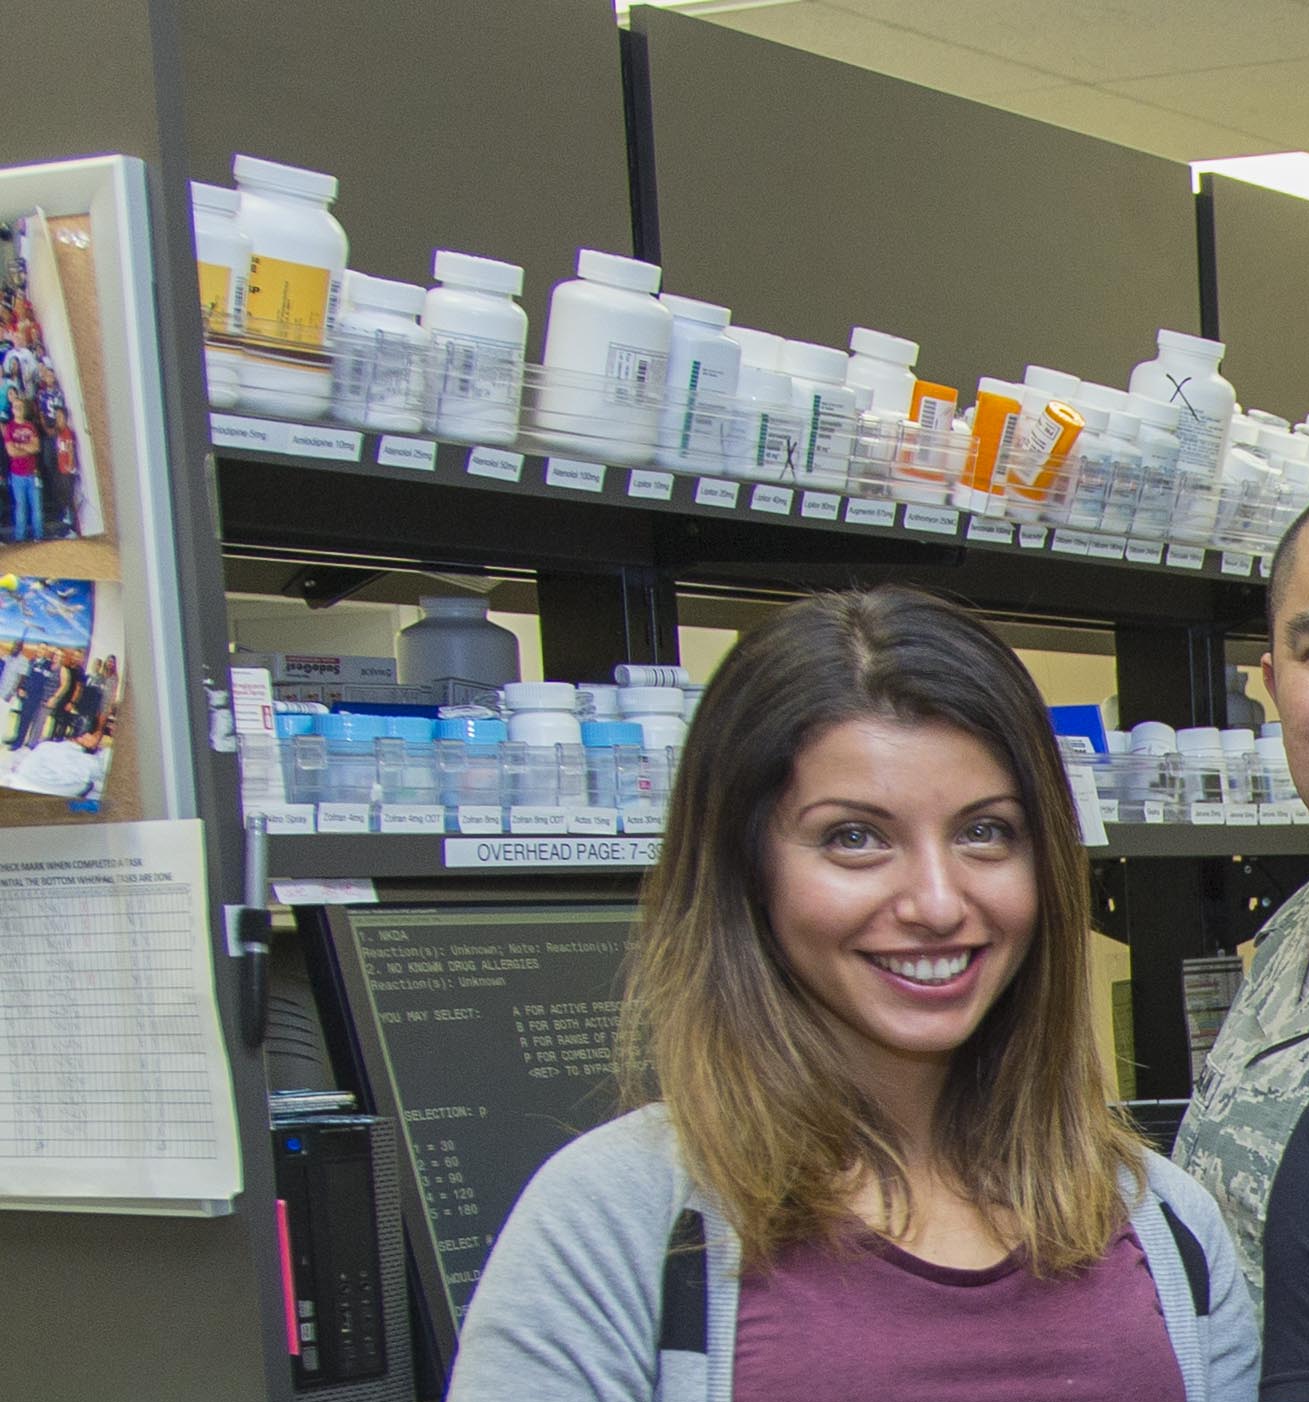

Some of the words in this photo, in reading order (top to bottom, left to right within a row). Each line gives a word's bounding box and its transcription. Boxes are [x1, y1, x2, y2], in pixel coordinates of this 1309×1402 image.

[477, 842, 573, 862] OVERHEAD
[576, 842, 625, 861] PAGE:
[408, 961, 444, 973] KNOWN
[448, 960, 476, 972] DRUG
[481, 958, 540, 971] ALLERGIES
[458, 976, 506, 988] Unknown
[433, 1008, 481, 1021] SELECT:
[561, 1047, 612, 1061] COMBINED
[403, 1106, 473, 1122] SELECTION:
